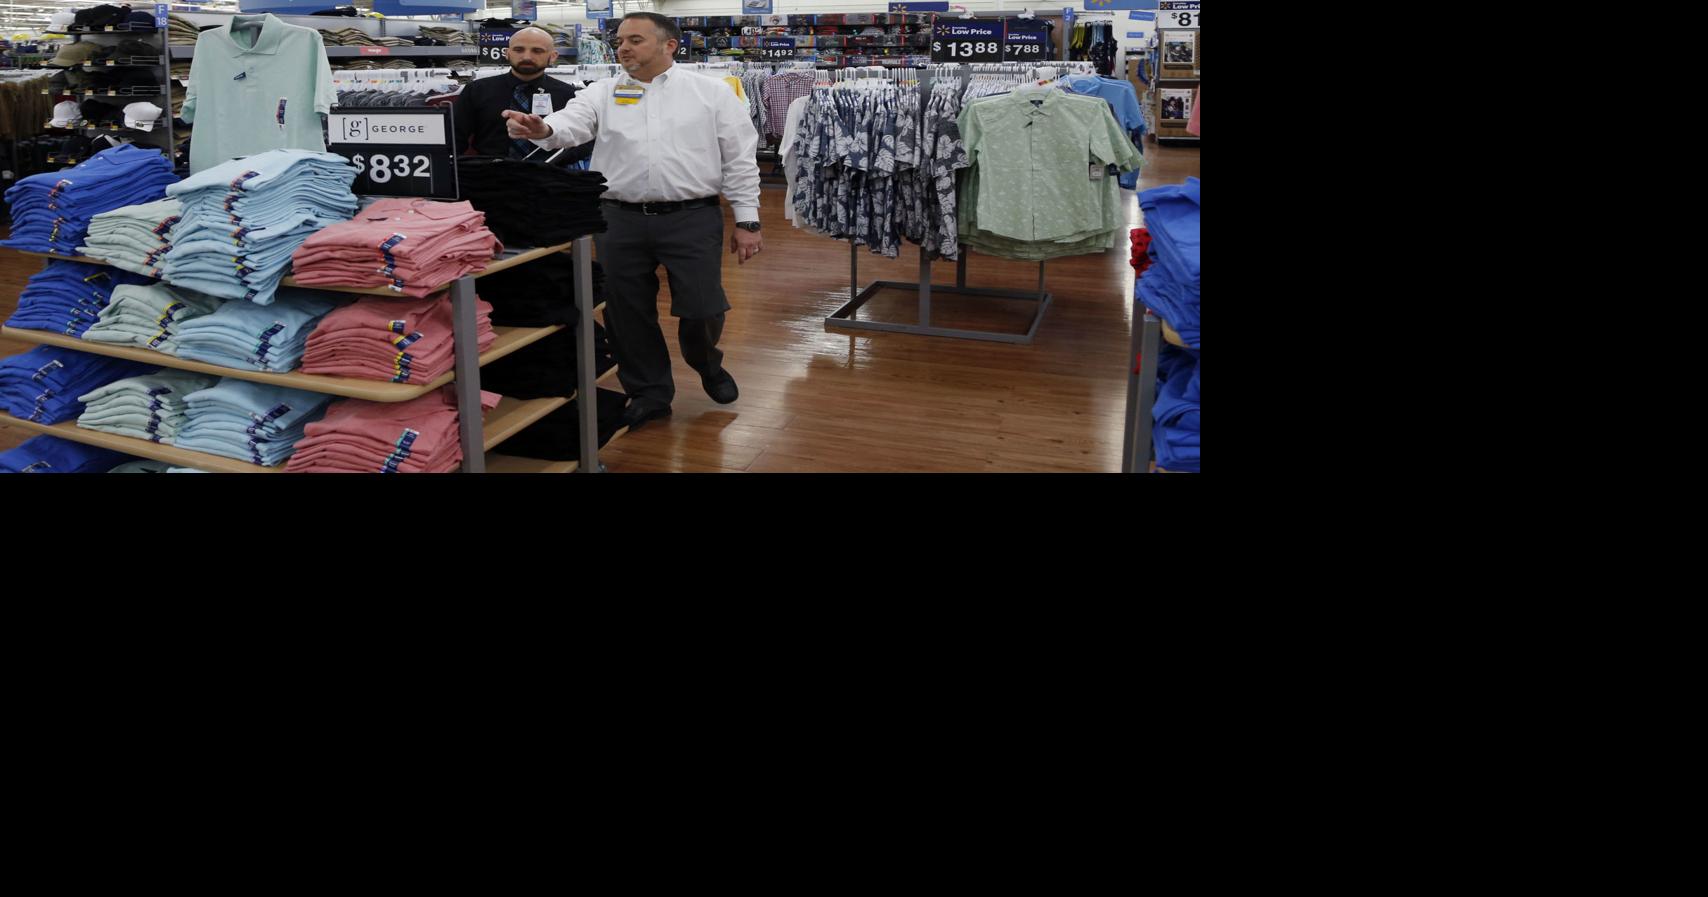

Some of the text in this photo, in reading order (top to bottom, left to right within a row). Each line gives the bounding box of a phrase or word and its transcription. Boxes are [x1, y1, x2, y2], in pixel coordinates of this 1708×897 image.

[158, 5, 165, 14] F
[156, 17, 167, 25] 18
[371, 125, 425, 133] GEORGE
